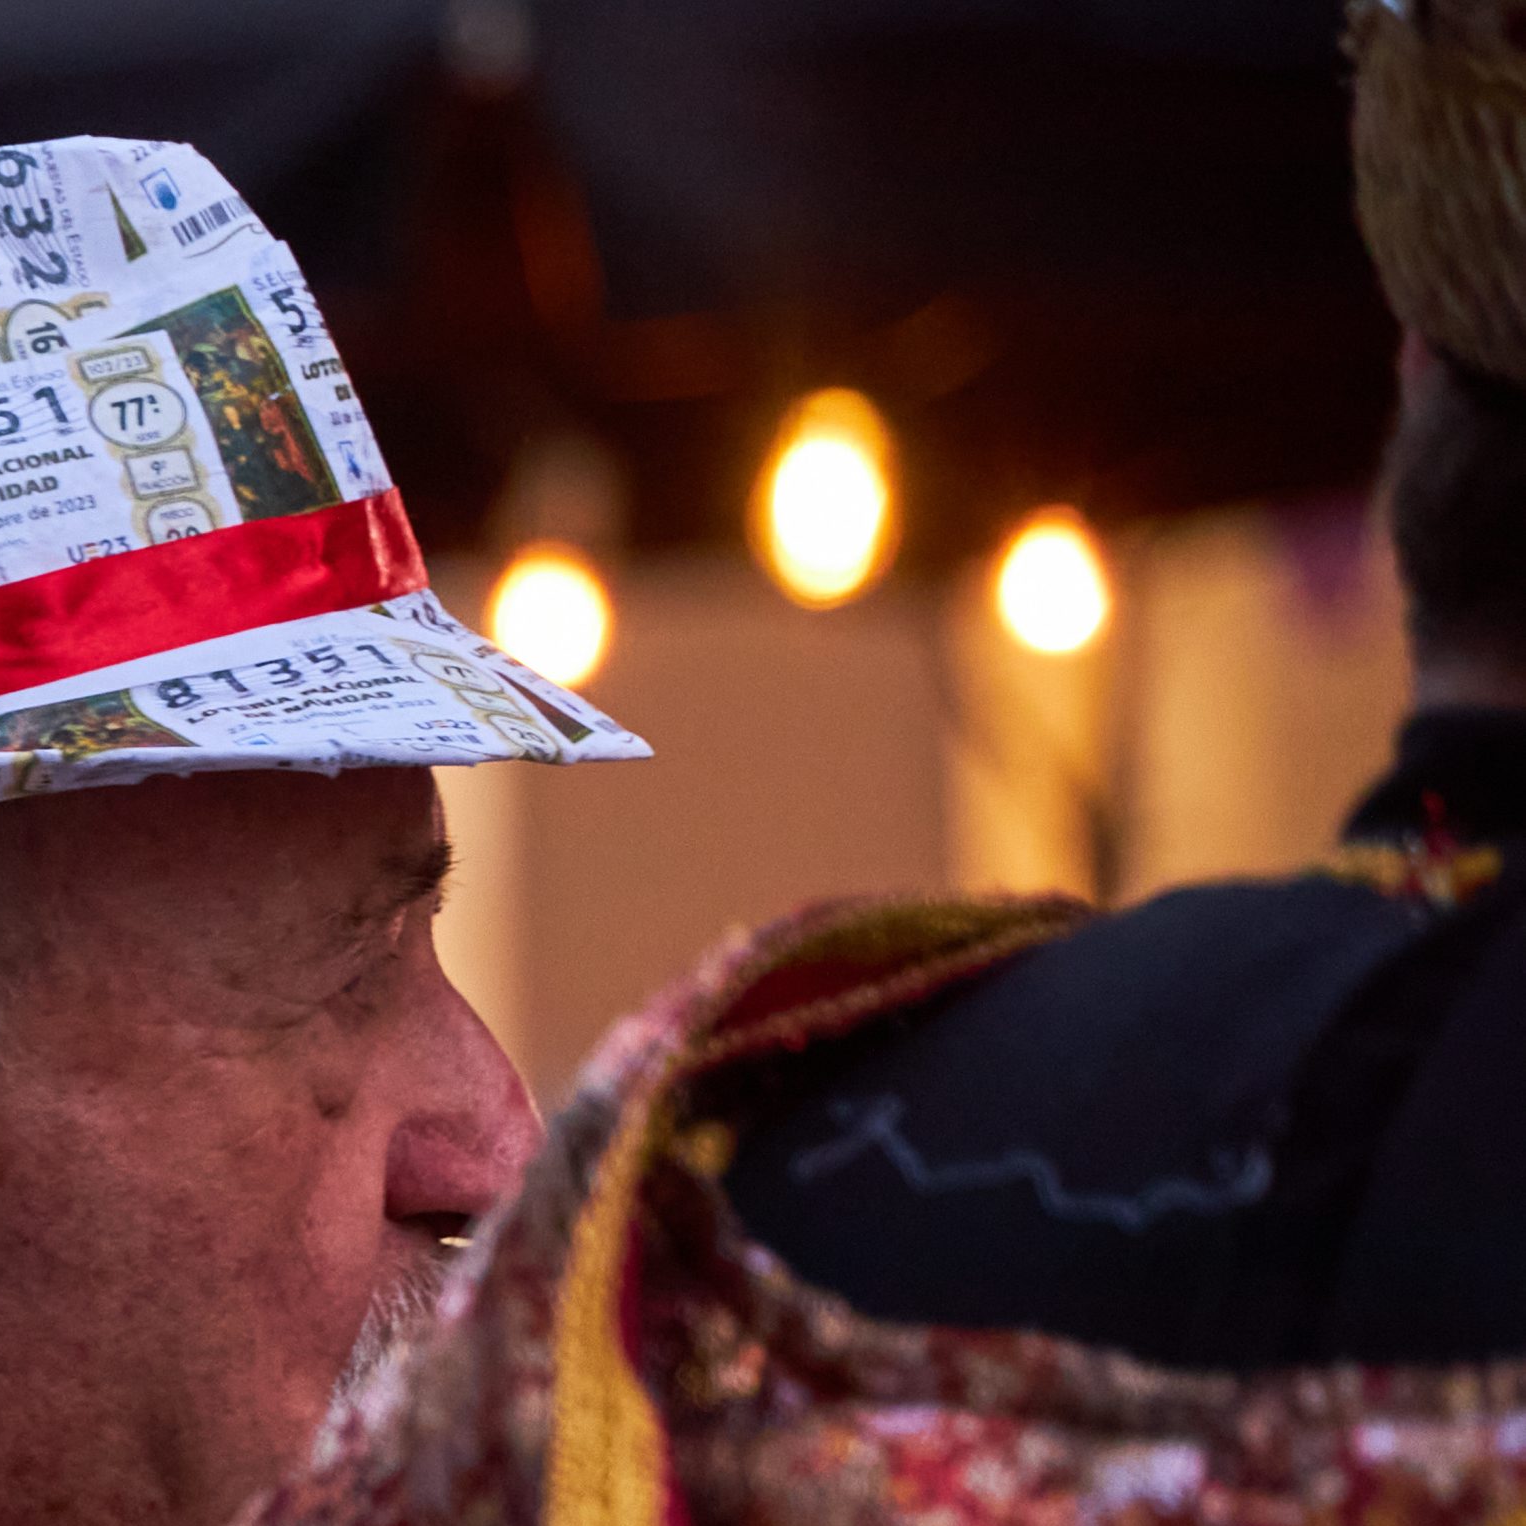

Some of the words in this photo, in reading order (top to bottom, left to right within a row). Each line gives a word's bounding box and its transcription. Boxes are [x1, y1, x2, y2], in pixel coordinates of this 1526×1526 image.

[27, 504, 51, 523] de
[54, 494, 97, 517] 2023
[153, 643, 394, 710] 81351
[185, 690, 294, 724] LOTERÍA
[301, 674, 425, 703] NACIONAL
[285, 689, 395, 717] NAVIDAD
